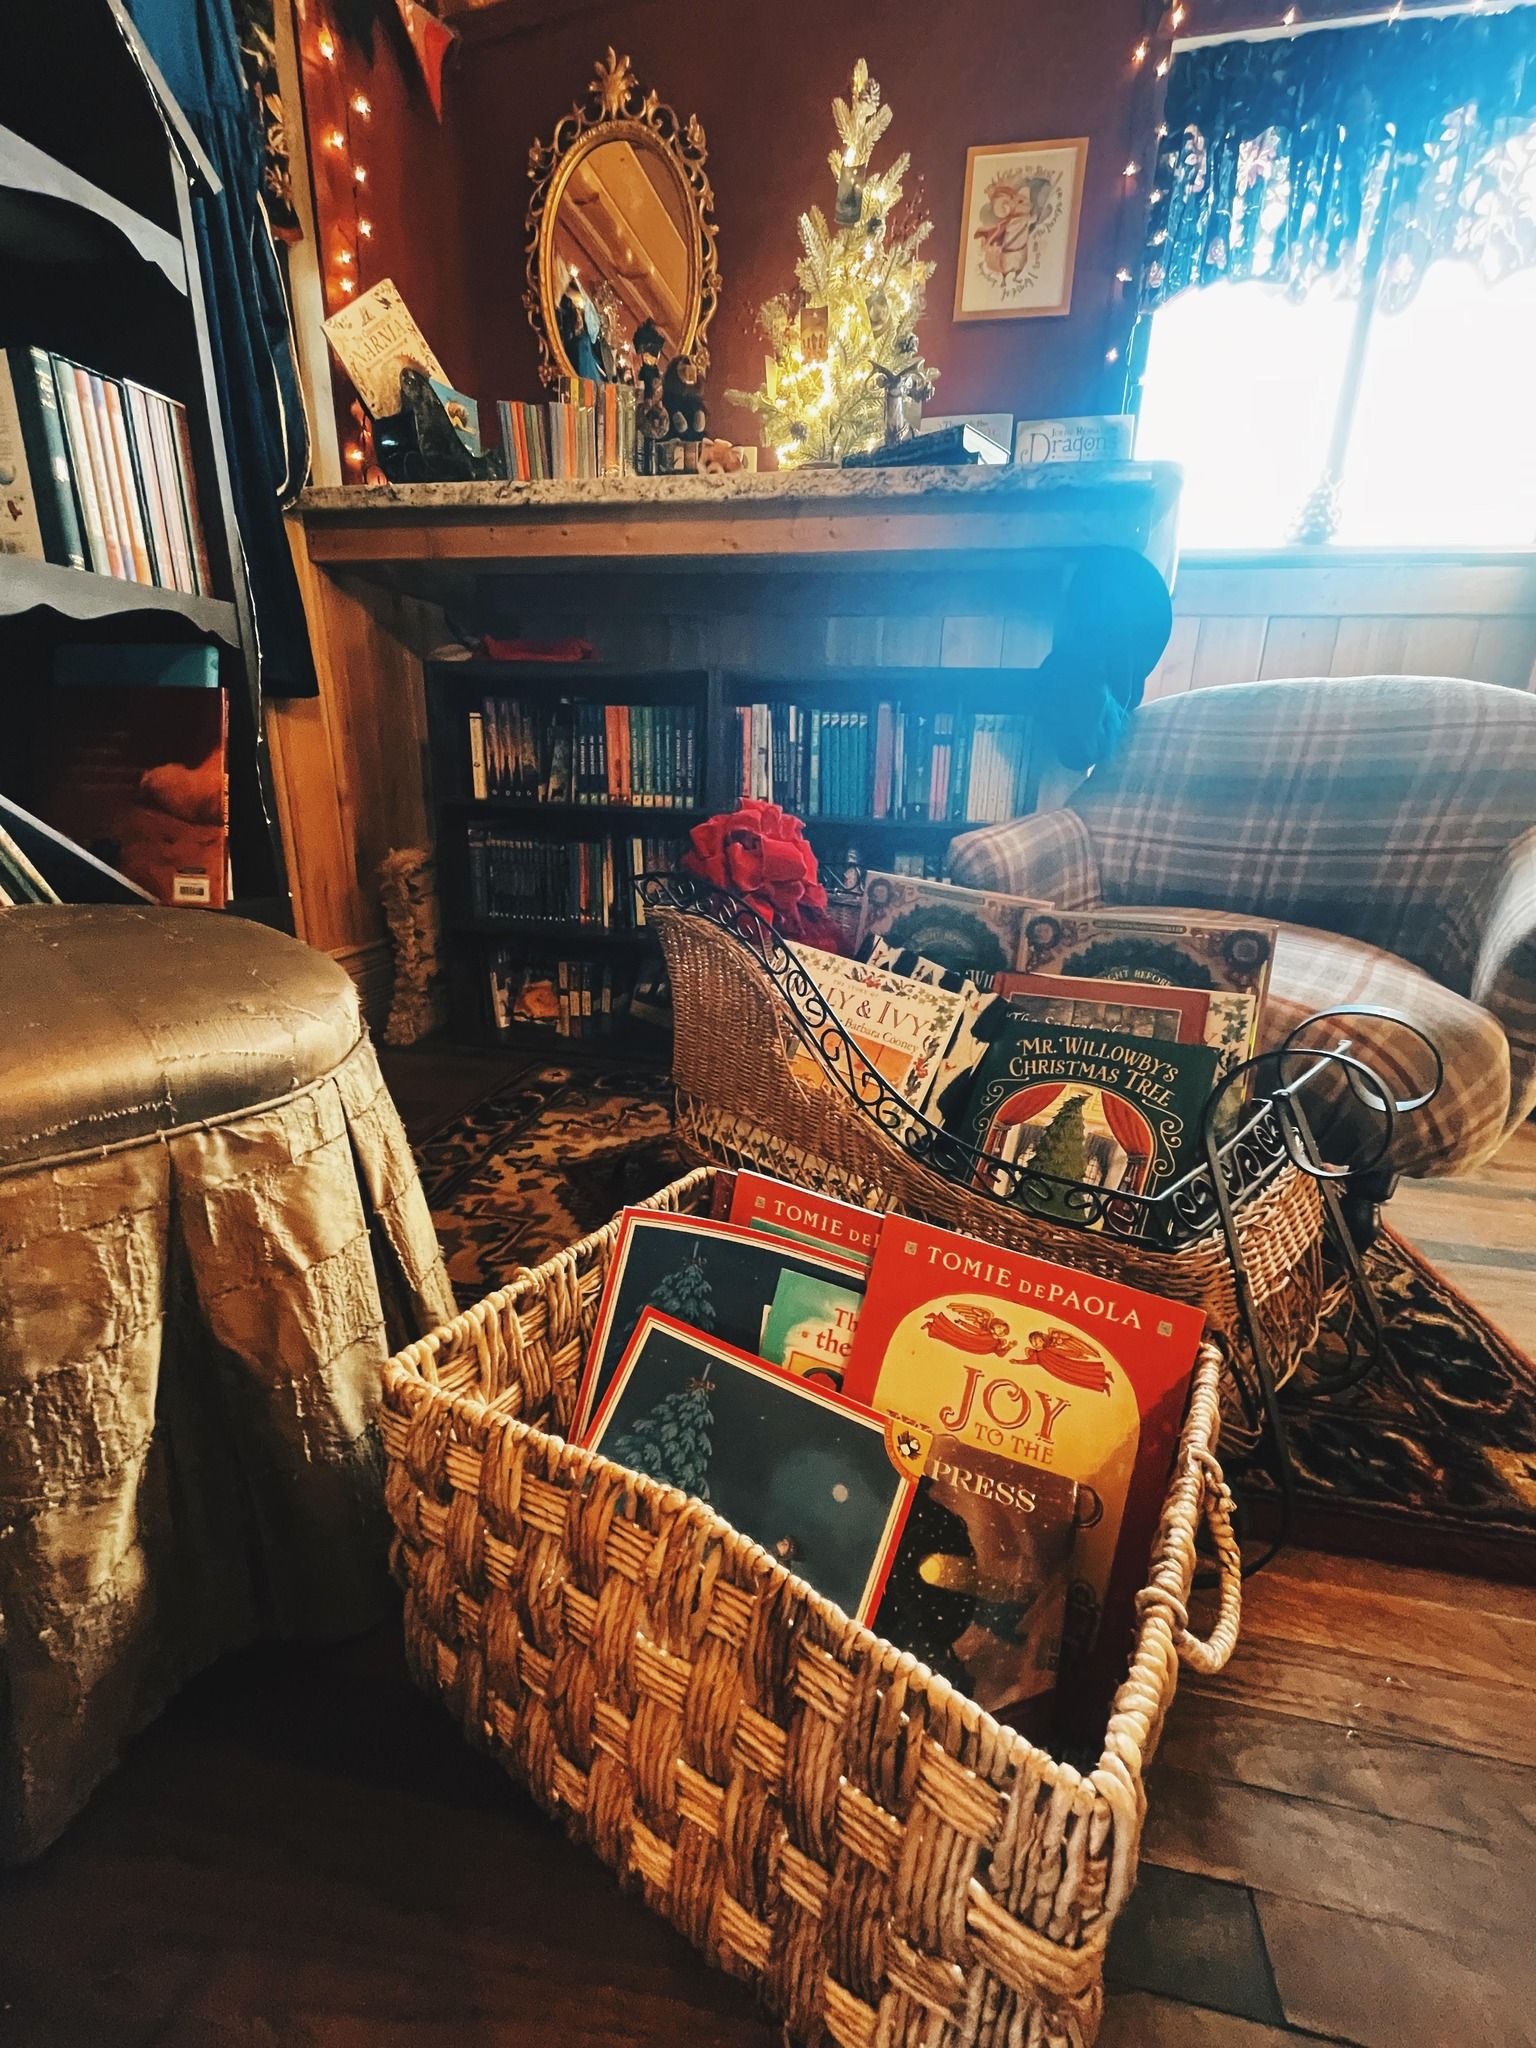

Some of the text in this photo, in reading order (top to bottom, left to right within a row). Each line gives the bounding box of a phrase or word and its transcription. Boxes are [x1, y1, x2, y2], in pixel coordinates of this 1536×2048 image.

[350, 319, 407, 364] NARNIA
[845, 1018, 919, 1053] Barbara Cooney
[856, 999, 871, 1019] &
[877, 1001, 929, 1036] IVY
[1016, 1036, 1179, 1083] MR. WILLOWBY'S
[1009, 1057, 1176, 1107] CHRISTMAS TREE
[774, 1200, 843, 1236] TOMIE
[927, 1246, 1013, 1288] TOMIE
[816, 1328, 852, 1358] the
[939, 1365, 1072, 1444] JOY
[974, 1422, 1054, 1466] TO THE
[931, 1459, 1036, 1513] PRESS
